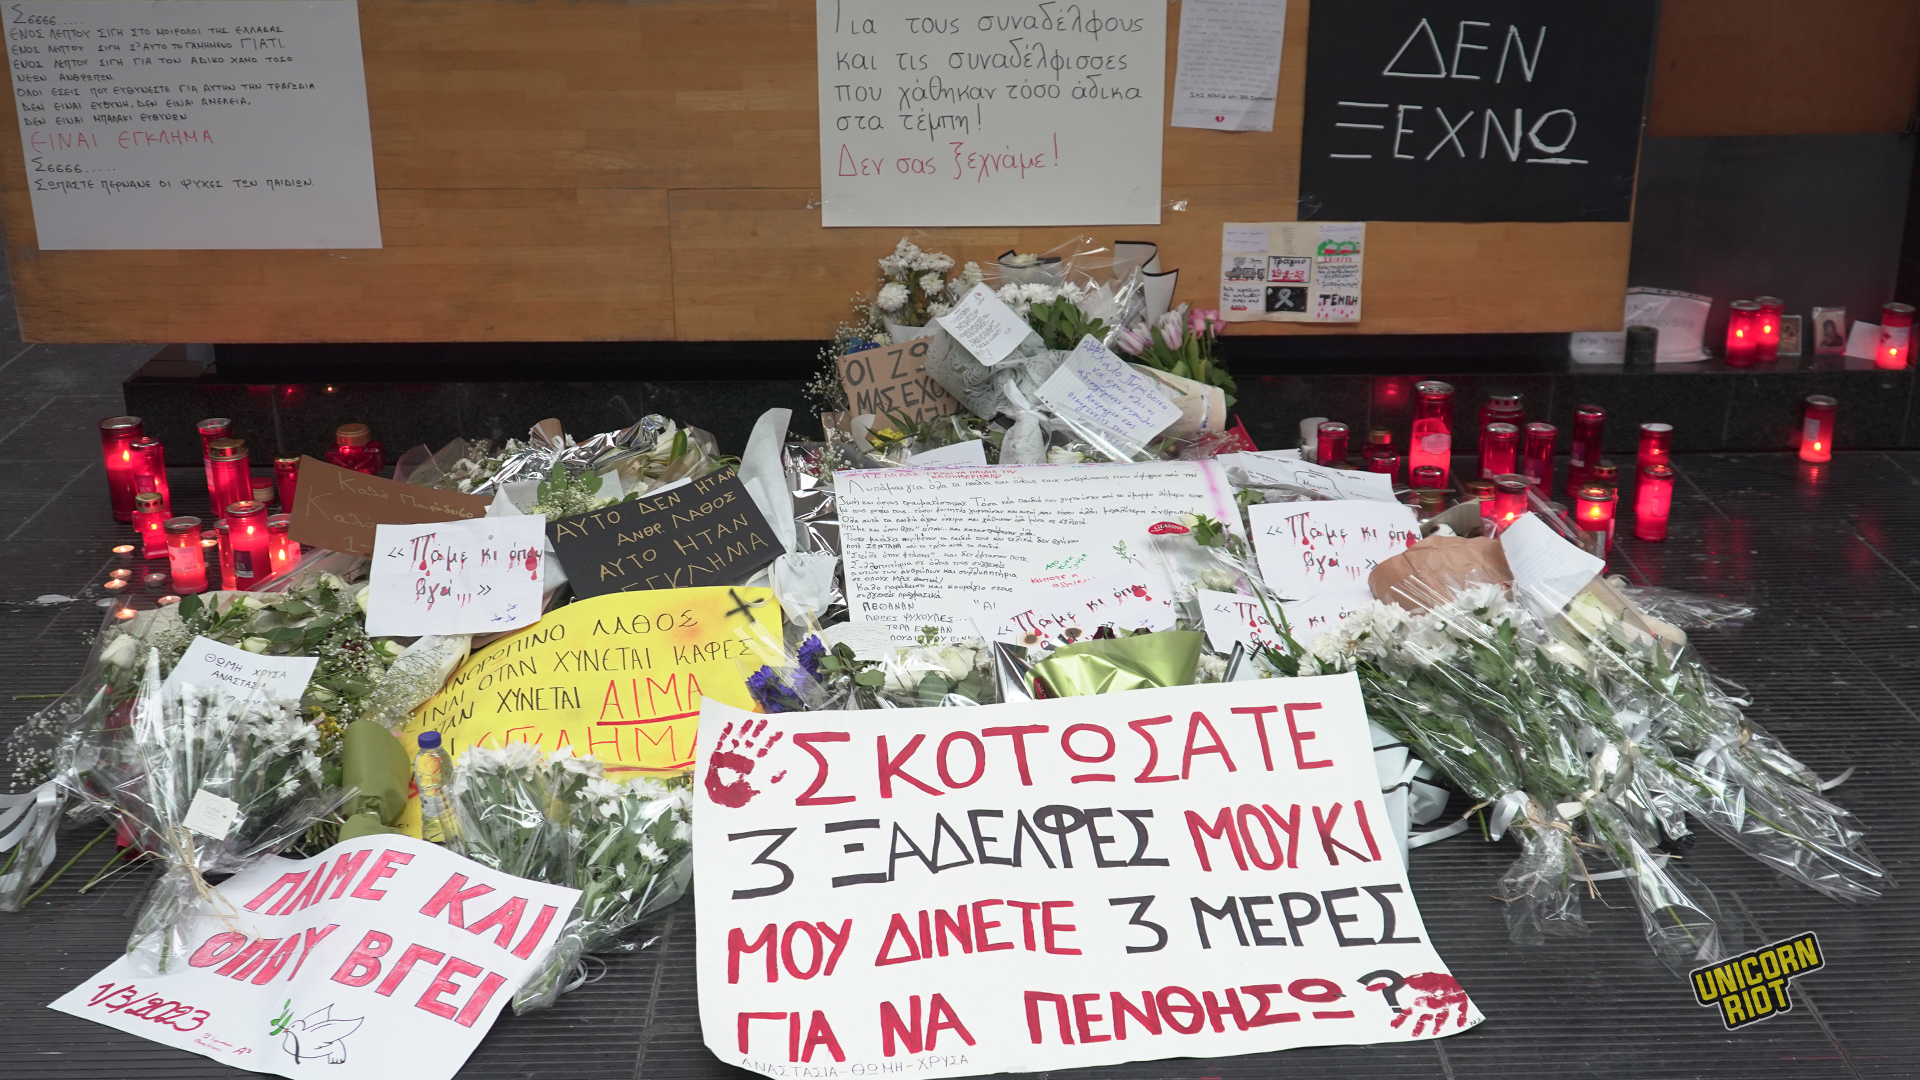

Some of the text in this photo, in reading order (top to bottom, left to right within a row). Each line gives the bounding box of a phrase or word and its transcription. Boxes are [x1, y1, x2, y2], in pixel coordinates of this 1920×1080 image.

[10, 28, 45, 40] ΕΝΟΣ
[50, 29, 91, 40] ΛΕΠΤΟΥ
[97, 28, 124, 38] ΣΙΓΗ
[131, 28, 151, 37] ΣΤΟ
[235, 26, 284, 35] ΕΛΛΑΔΑΣ
[905, 16, 960, 34] τους
[977, 1, 1145, 41] συναδέλφους
[11, 45, 41, 55] ΕΝΟΣ
[48, 45, 84, 54] ΛΕΠΤΟΥ
[13, 60, 44, 69] ΕΝΟΣ
[54, 59, 88, 69] ΛΕΠΤΟΥ
[99, 59, 124, 67] ΣΙΓΗ
[133, 57, 152, 65] ΓΙΑ
[837, 37, 1128, 81] και τις συναδέλφισσες
[1382, 17, 1547, 84] ΔΕΝ
[17, 88, 42, 97] ΟΛΟΙ
[90, 87, 108, 98] ΠΟΥ
[179, 84, 199, 93] ΓΙΑ
[203, 83, 236, 92] ΑΥΤΗΝ
[241, 82, 262, 90] ΤΗΝ
[22, 103, 45, 112] ΔΕΝ
[54, 102, 82, 111] ΕΙΝΑΙ
[137, 100, 158, 108] ΔΕΝ
[166, 99, 194, 108] ΕΙΝΑΙ
[835, 73, 1142, 110] που χάθηκαν τόσο άδικα
[24, 117, 46, 126] ΔΕΝ
[56, 117, 84, 126] ΕΙΝΑΙ
[836, 115, 884, 131] στα
[30, 130, 214, 153] ΕΙΝΑΙ ΕΓΚΛΗΜΑ
[838, 143, 885, 177] Δεν
[895, 156, 936, 175] σας
[180, 179, 223, 190] ΨΥΧΕΣ
[845, 356, 876, 387] ΟΙ
[338, 471, 389, 499] Καλό
[556, 467, 736, 542] ΑΥΤΟ ΔΕΝ ΗΤΑΝ
[671, 490, 737, 529] ΛΑΘΟΣ
[600, 513, 748, 581] ΑΥΤΟ ΗΤΑΝ
[592, 609, 698, 635] ΛΑΘΟΣ
[251, 669, 287, 679] ΧΡΥΣΑ
[478, 656, 537, 691] ΟΤΑΝ
[553, 647, 651, 673] ΧΥΝΕΤΑΙ
[673, 637, 754, 665] ΚΑΦΕΣ
[497, 686, 581, 714] ΧΥΝΕΤΑΙ
[600, 673, 703, 720] ΑΙΜΑ
[793, 702, 1334, 806] ΣΚΟΤΩΣΑΤΕ
[727, 799, 1382, 899] 3 ΞΑΔΕΛΦΕΣ ΜΟΥ ΚΙ
[243, 848, 559, 960] ΠΑΜΕ ΚΑΙ
[728, 883, 1422, 984] ΜΟΥ ΔΙΝΕΤΕ 3 ΜΕΡΕΣ
[188, 923, 508, 1028] ΟΠΟΥ ΒΓΕΙ
[737, 1009, 846, 1063] ΓΙΑ
[880, 993, 976, 1057] ΝΑ
